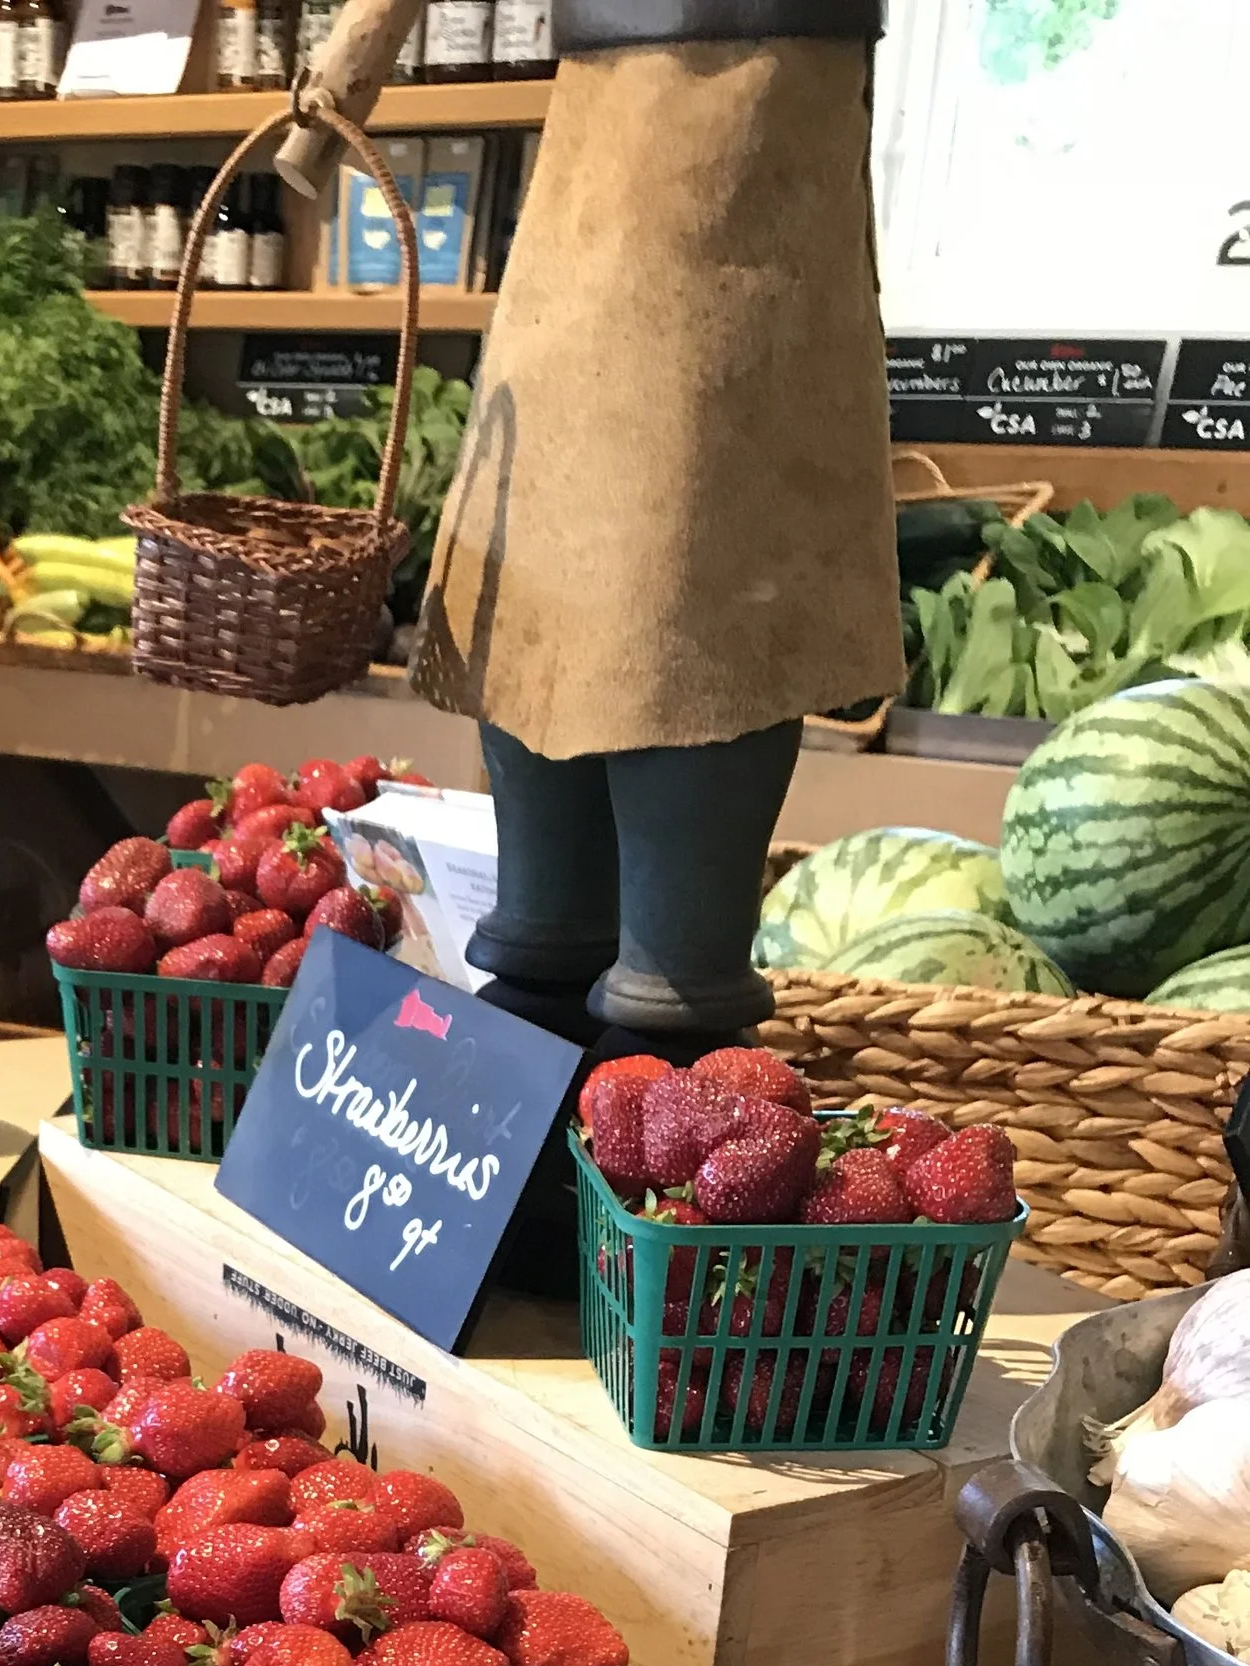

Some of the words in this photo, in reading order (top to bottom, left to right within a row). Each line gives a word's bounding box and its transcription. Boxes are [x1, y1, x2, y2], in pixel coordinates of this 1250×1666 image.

[991, 413, 1036, 435] CSA
[1196, 418, 1245, 440] CSA
[295, 1029, 500, 1201] Strawberries
[230, 1271, 261, 1296] STUFF
[264, 1291, 299, 1317] UDDER
[301, 1311, 318, 1330] NO
[324, 1329, 359, 1352] JERKY
[360, 1348, 387, 1371] BEEF
[390, 1366, 416, 1388] JUST
